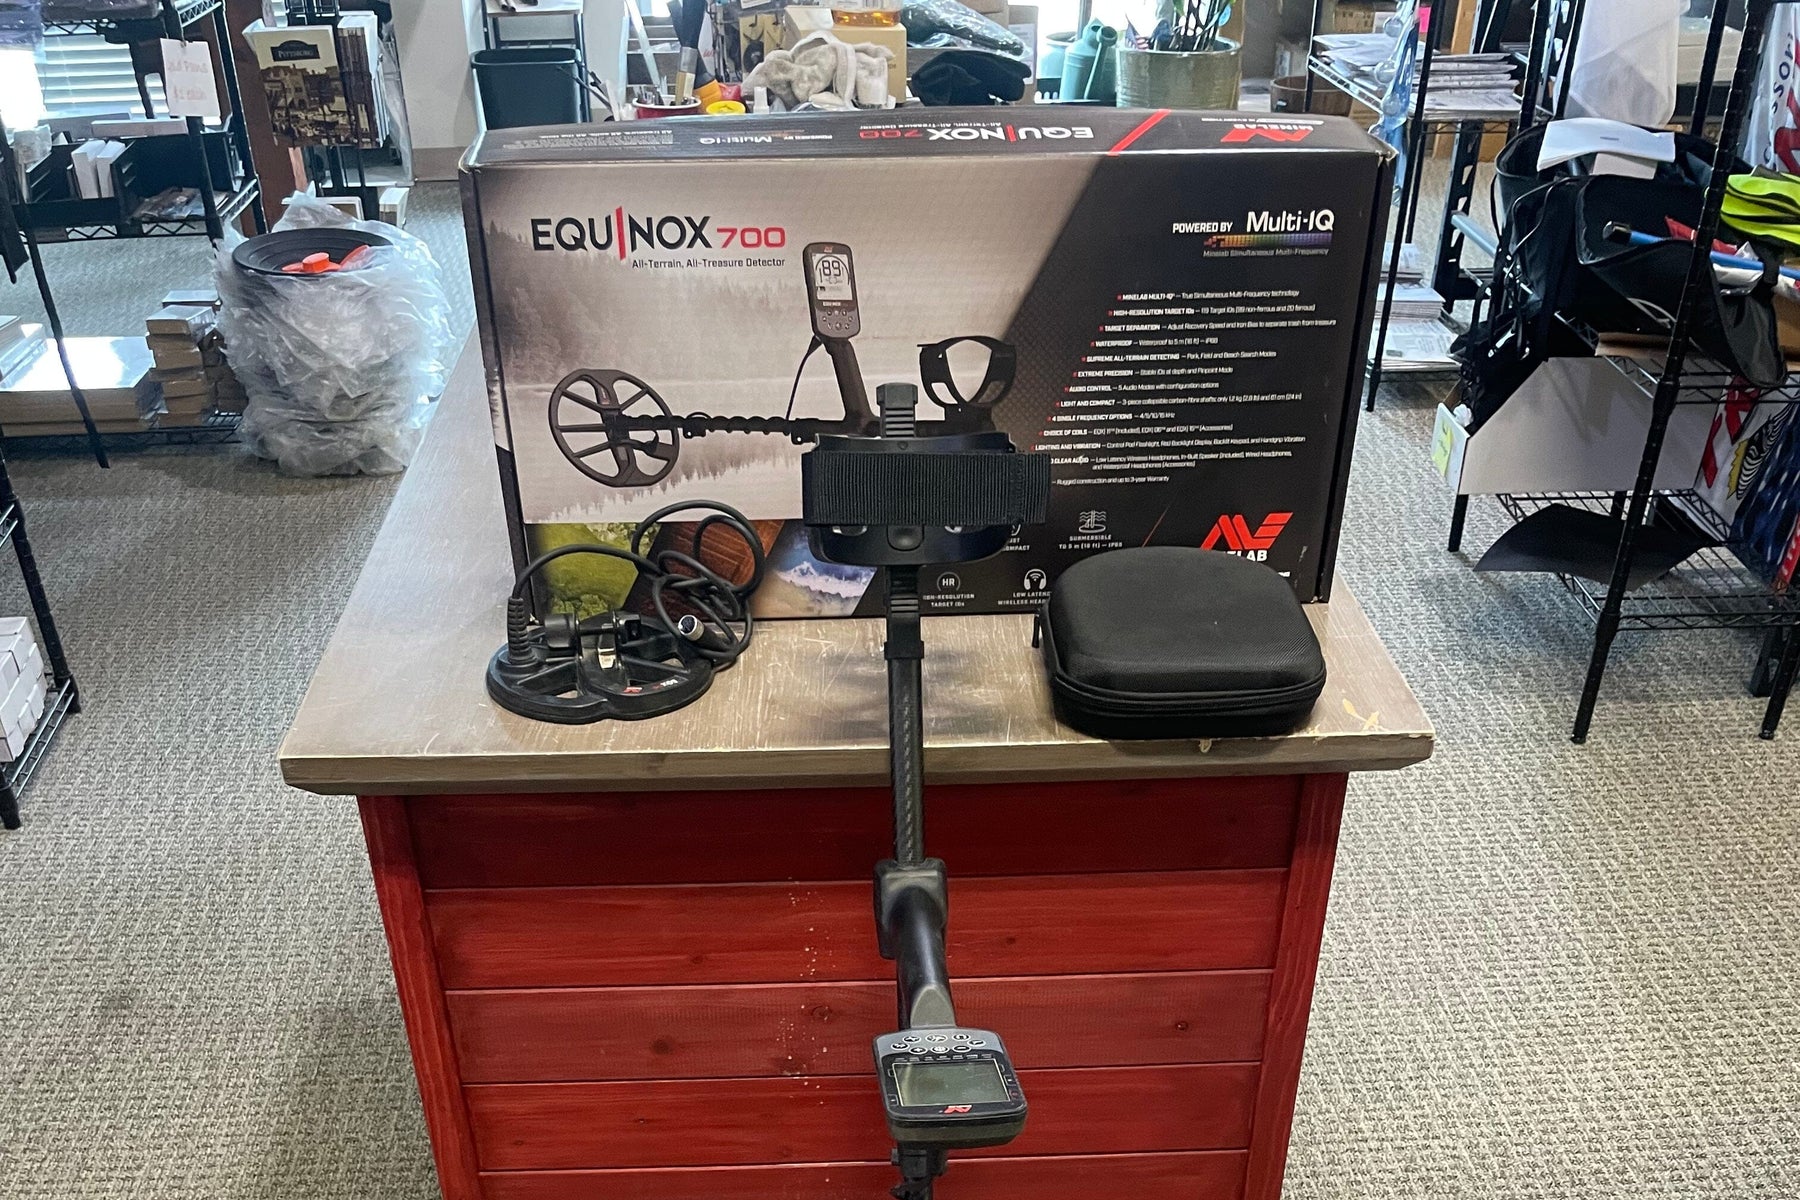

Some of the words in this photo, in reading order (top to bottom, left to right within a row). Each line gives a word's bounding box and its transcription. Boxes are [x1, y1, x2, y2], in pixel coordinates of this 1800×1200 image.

[926, 124, 1094, 142] EQUINOX
[1172, 222, 1218, 234] POWERED
[1220, 222, 1233, 232] BY
[1246, 210, 1334, 233] Multi-IQ
[531, 207, 712, 260] EQUINOX
[717, 227, 786, 248] 700
[632, 260, 683, 270] All-Terrain,
[687, 259, 742, 268] All-Treasure
[746, 258, 786, 267] Detector
[942, 578, 955, 586] HR
